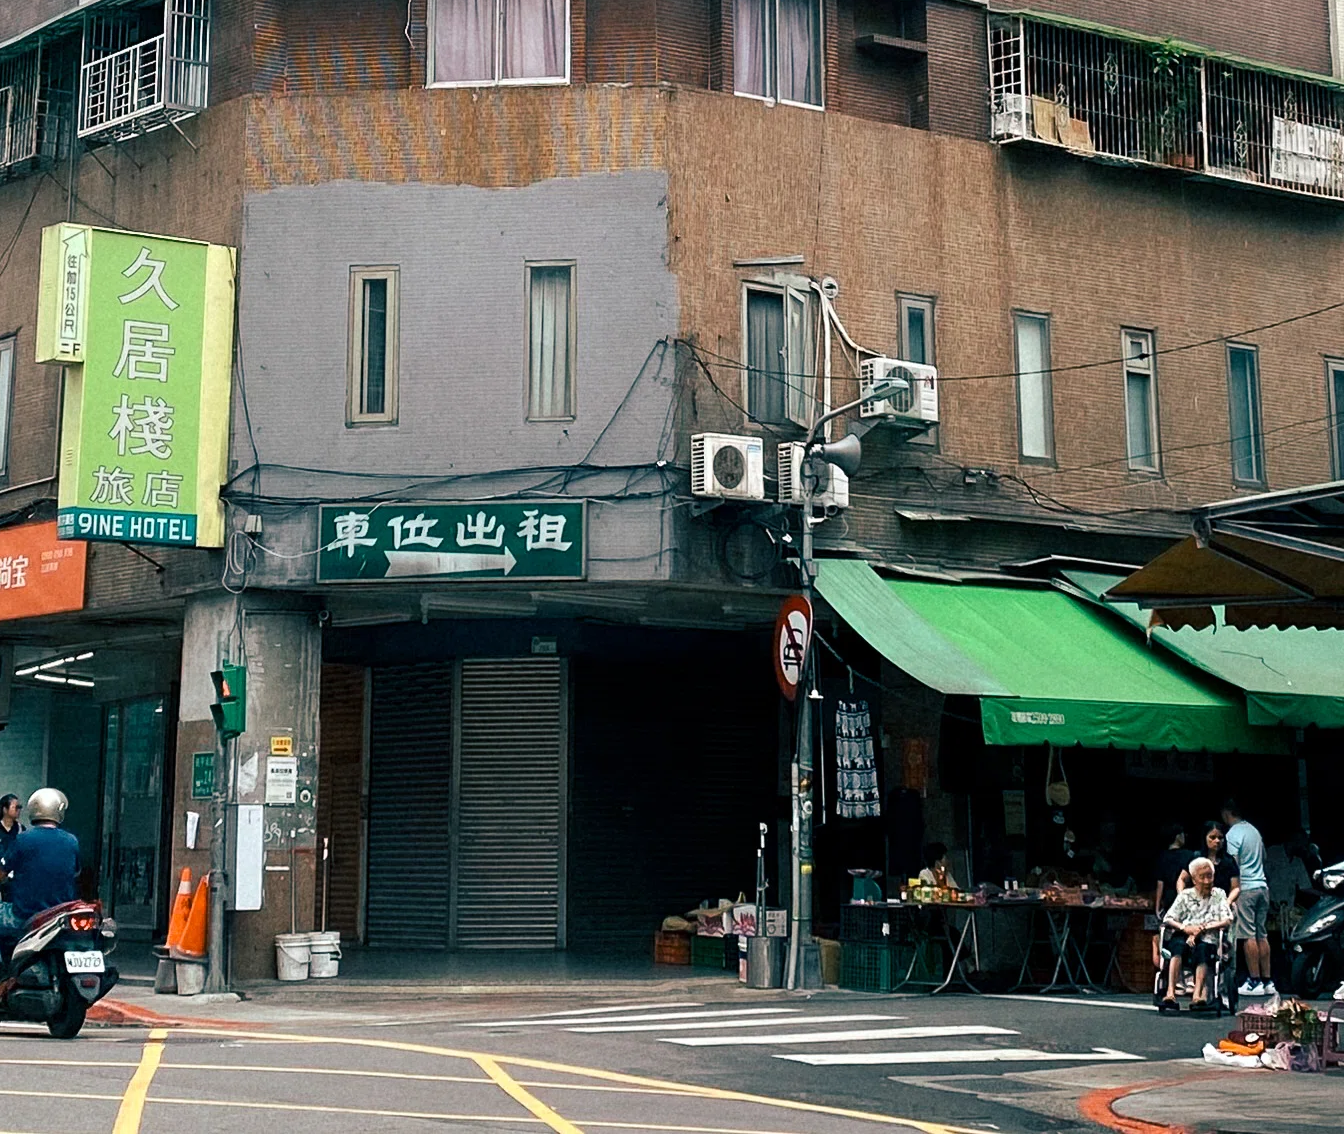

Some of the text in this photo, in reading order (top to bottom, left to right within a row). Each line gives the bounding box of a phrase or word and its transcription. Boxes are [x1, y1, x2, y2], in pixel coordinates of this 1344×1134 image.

[108, 246, 180, 460] 久居棧
[90, 466, 184, 508] 旅店
[78, 512, 123, 537] 9INE
[129, 517, 193, 541] HOTEL
[327, 509, 573, 558] 車位出租
